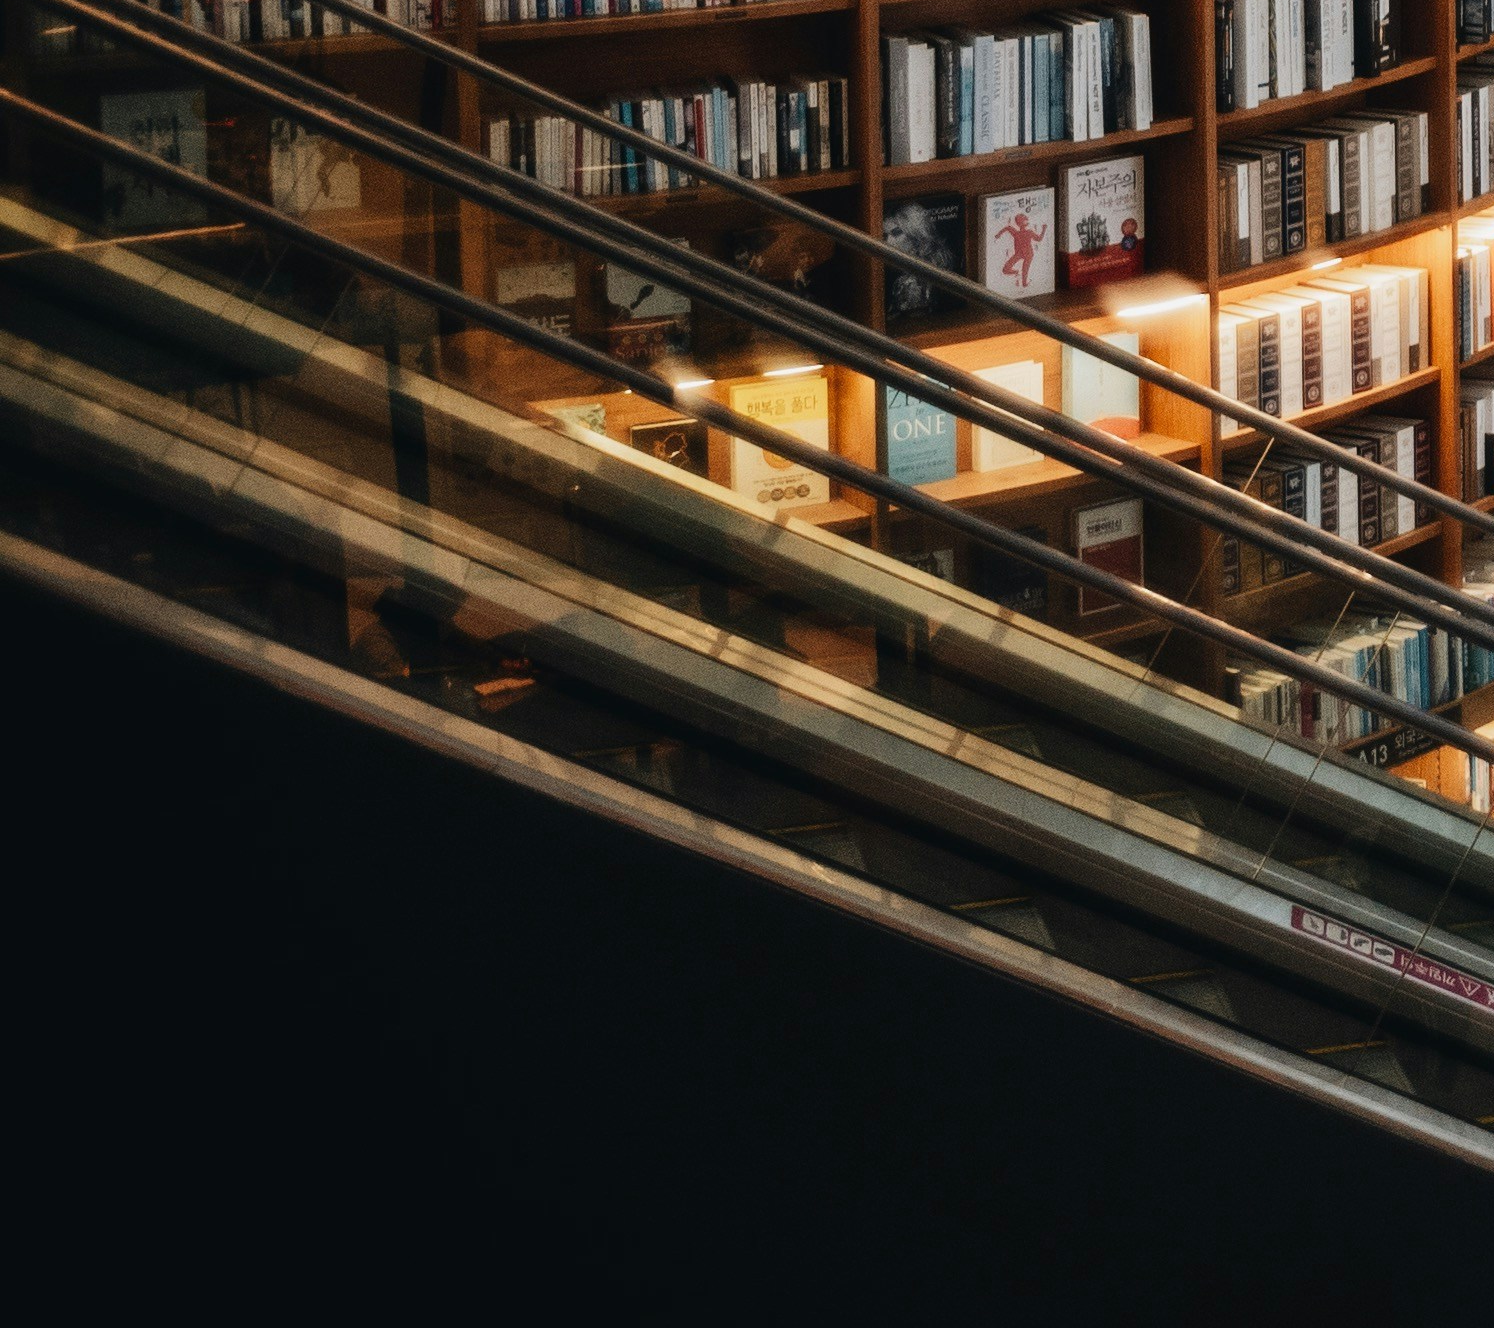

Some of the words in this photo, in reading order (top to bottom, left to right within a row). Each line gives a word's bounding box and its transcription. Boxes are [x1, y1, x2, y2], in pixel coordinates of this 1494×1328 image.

[1077, 170, 1137, 199] 자본주의
[746, 398, 786, 419] 행복을
[790, 394, 817, 414] 풀다
[893, 414, 946, 442] ONE
